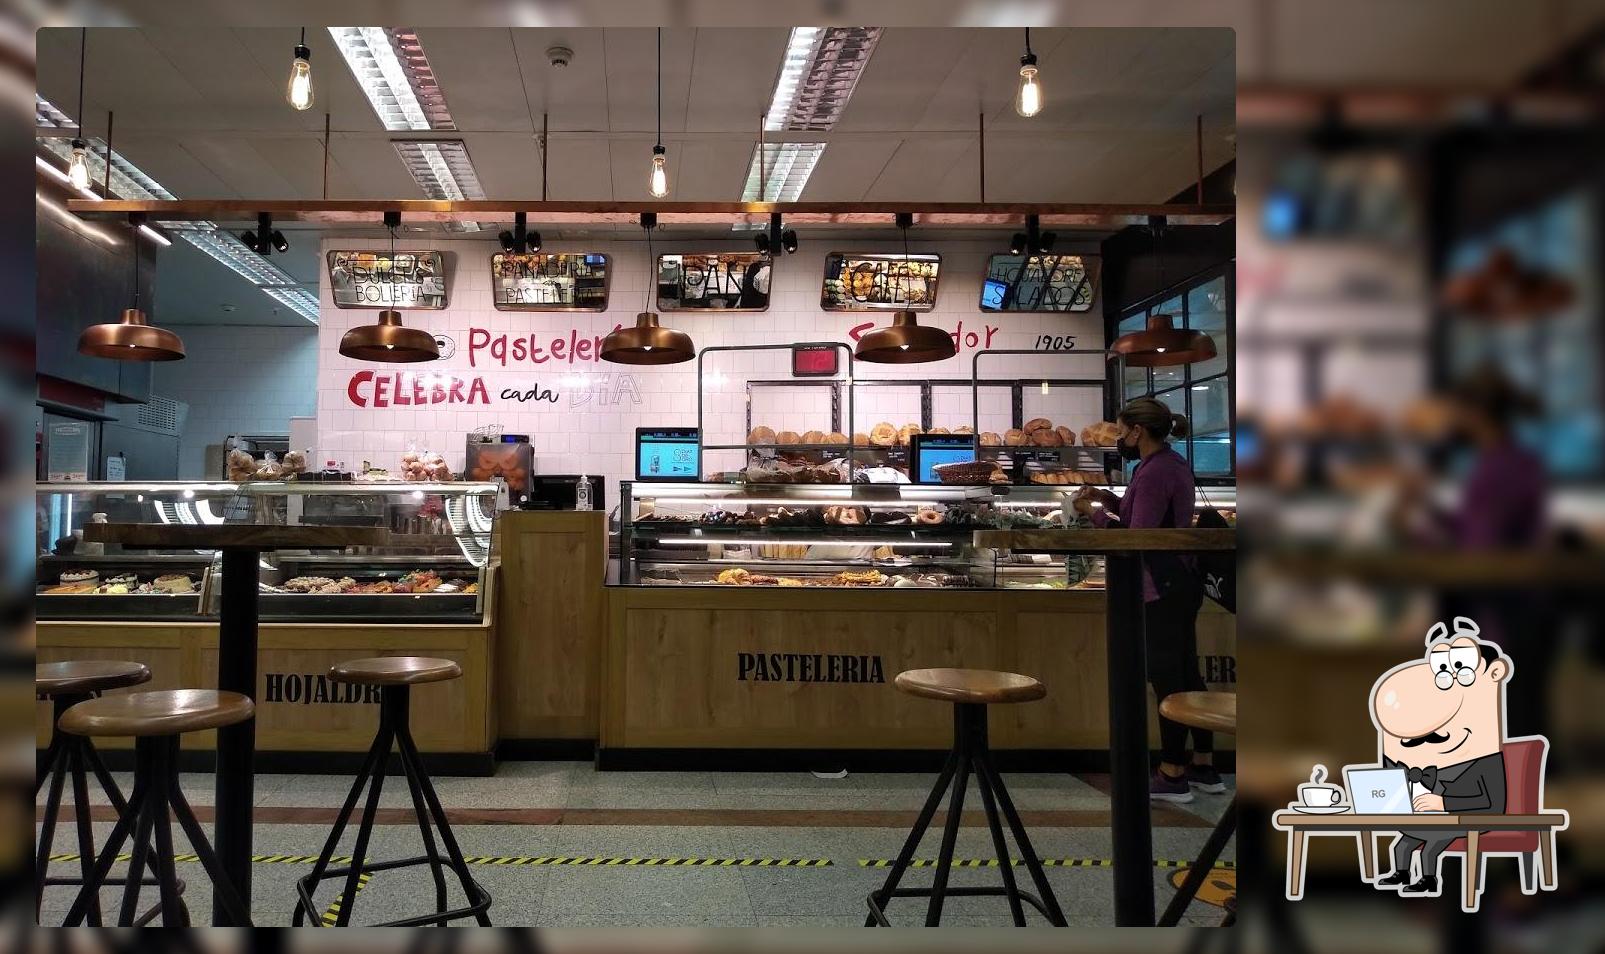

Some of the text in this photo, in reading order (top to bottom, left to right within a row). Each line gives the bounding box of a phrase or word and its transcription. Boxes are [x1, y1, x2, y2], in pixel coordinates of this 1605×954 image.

[682, 262, 747, 301] PAN
[469, 320, 999, 367] Pasteler Sdor
[1035, 334, 1078, 350] 1905
[347, 370, 491, 408] CELEBRA
[500, 383, 560, 403] cada
[737, 653, 886, 684] PASTELERIA
[265, 673, 382, 705] HOJALDR
